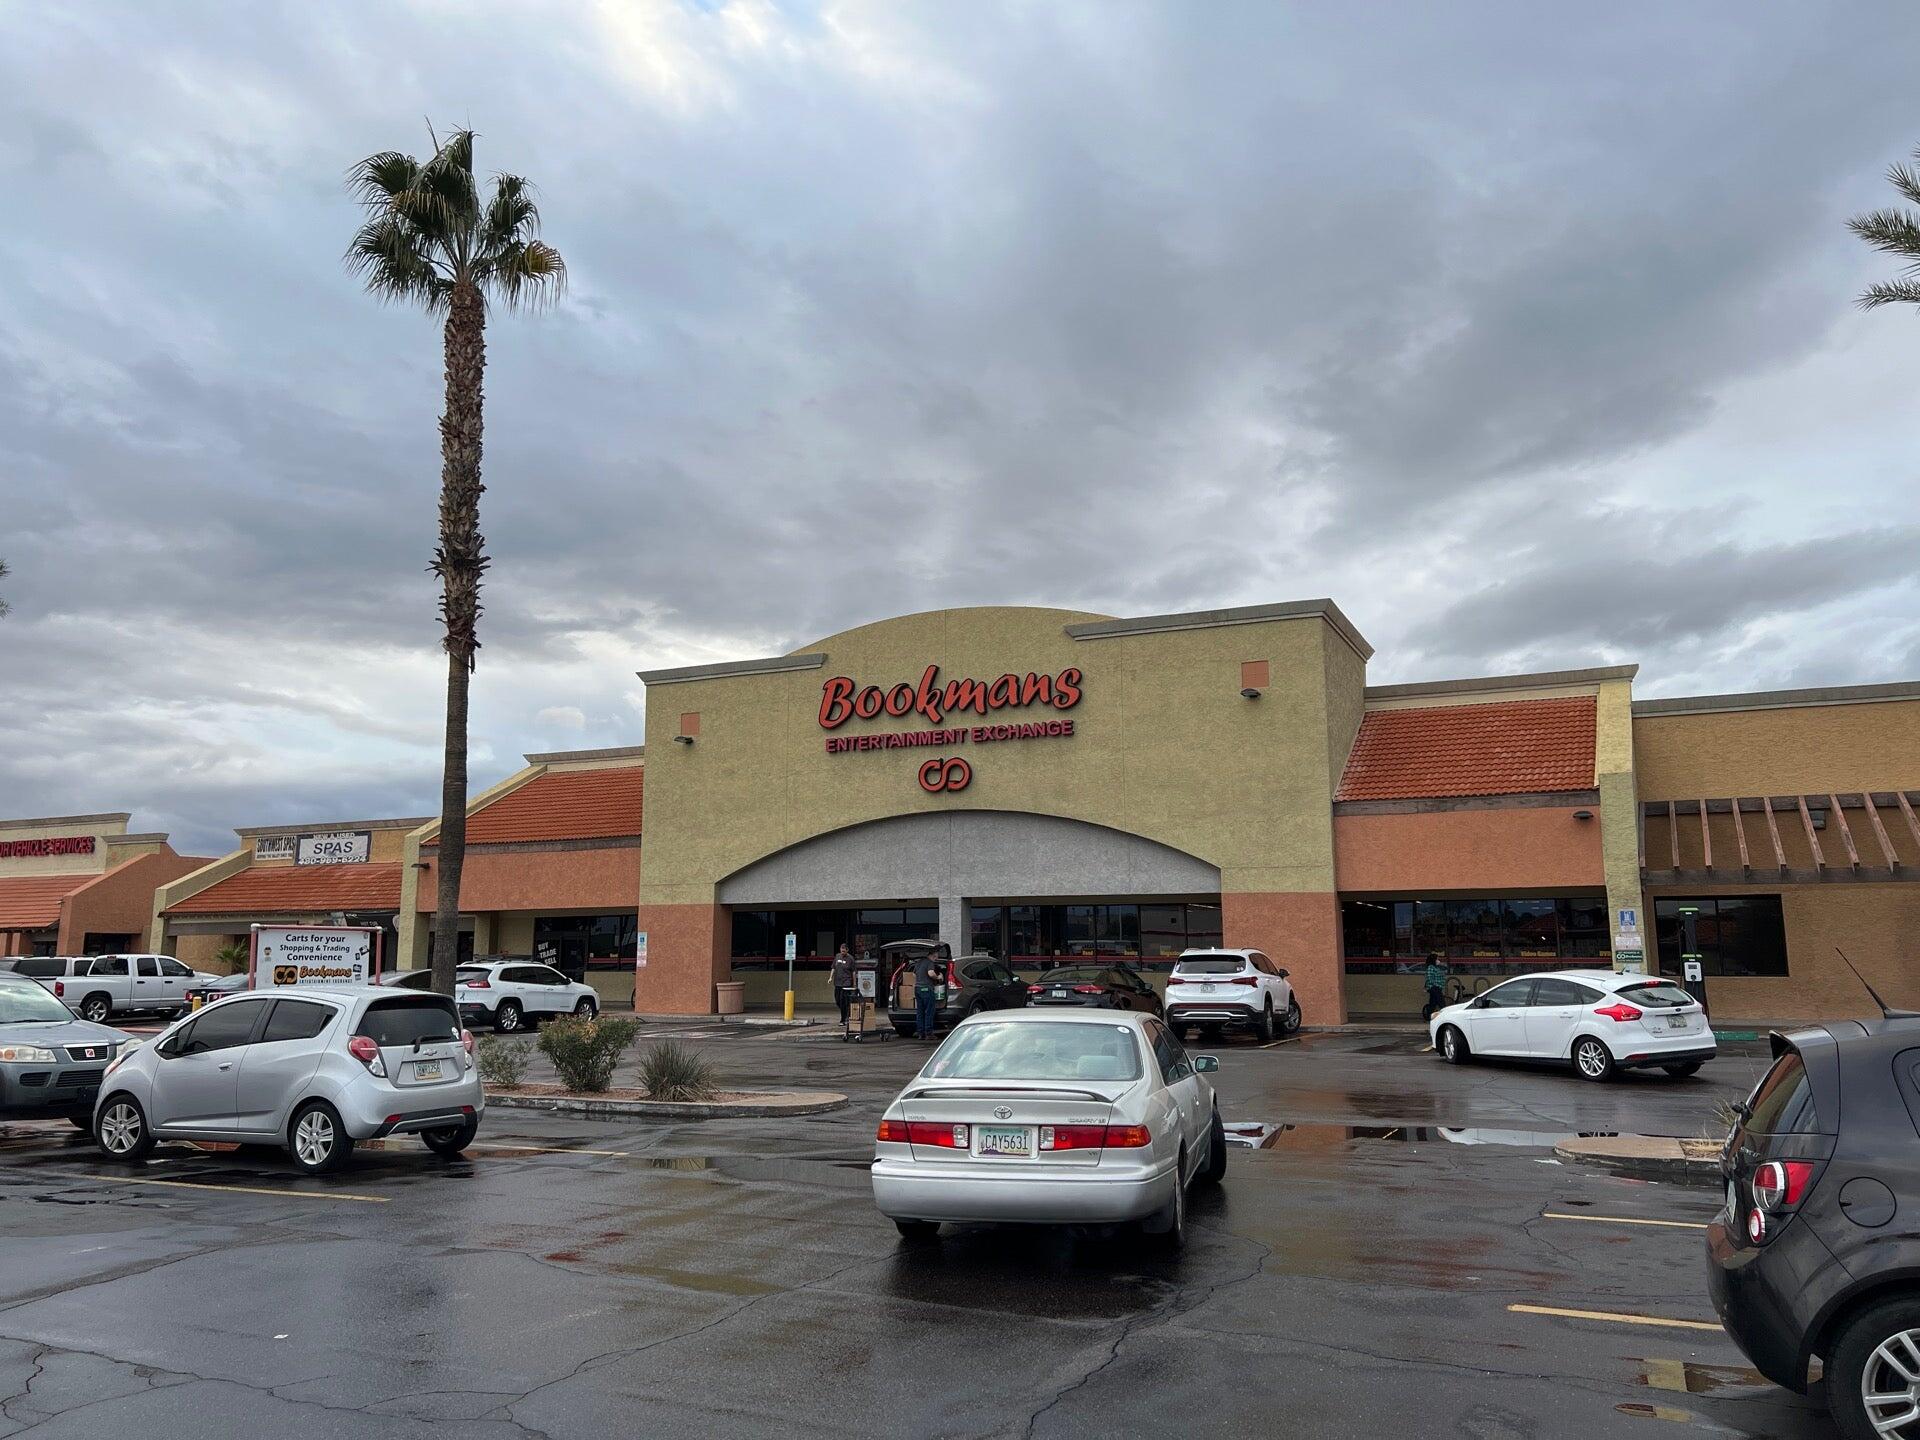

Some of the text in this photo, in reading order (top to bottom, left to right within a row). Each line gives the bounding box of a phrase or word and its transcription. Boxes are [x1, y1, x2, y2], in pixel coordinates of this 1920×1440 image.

[818, 664, 1082, 730] Bookmans
[825, 719, 1075, 753] ENTERTAINMENT EXCHANGE
[336, 832, 356, 840] USED
[11, 839, 49, 857] VEHICLE
[48, 836, 96, 856] SERVICES
[313, 841, 354, 855] SPAS
[285, 933, 346, 944] Carts for your
[280, 944, 314, 953] Shopping
[323, 944, 350, 953] Trading
[538, 942, 548, 951] BUY
[286, 953, 343, 961] Convenience
[540, 948, 556, 958] TRADE
[299, 964, 352, 978] Bookmans
[985, 1134, 1029, 1150] CAY5631
